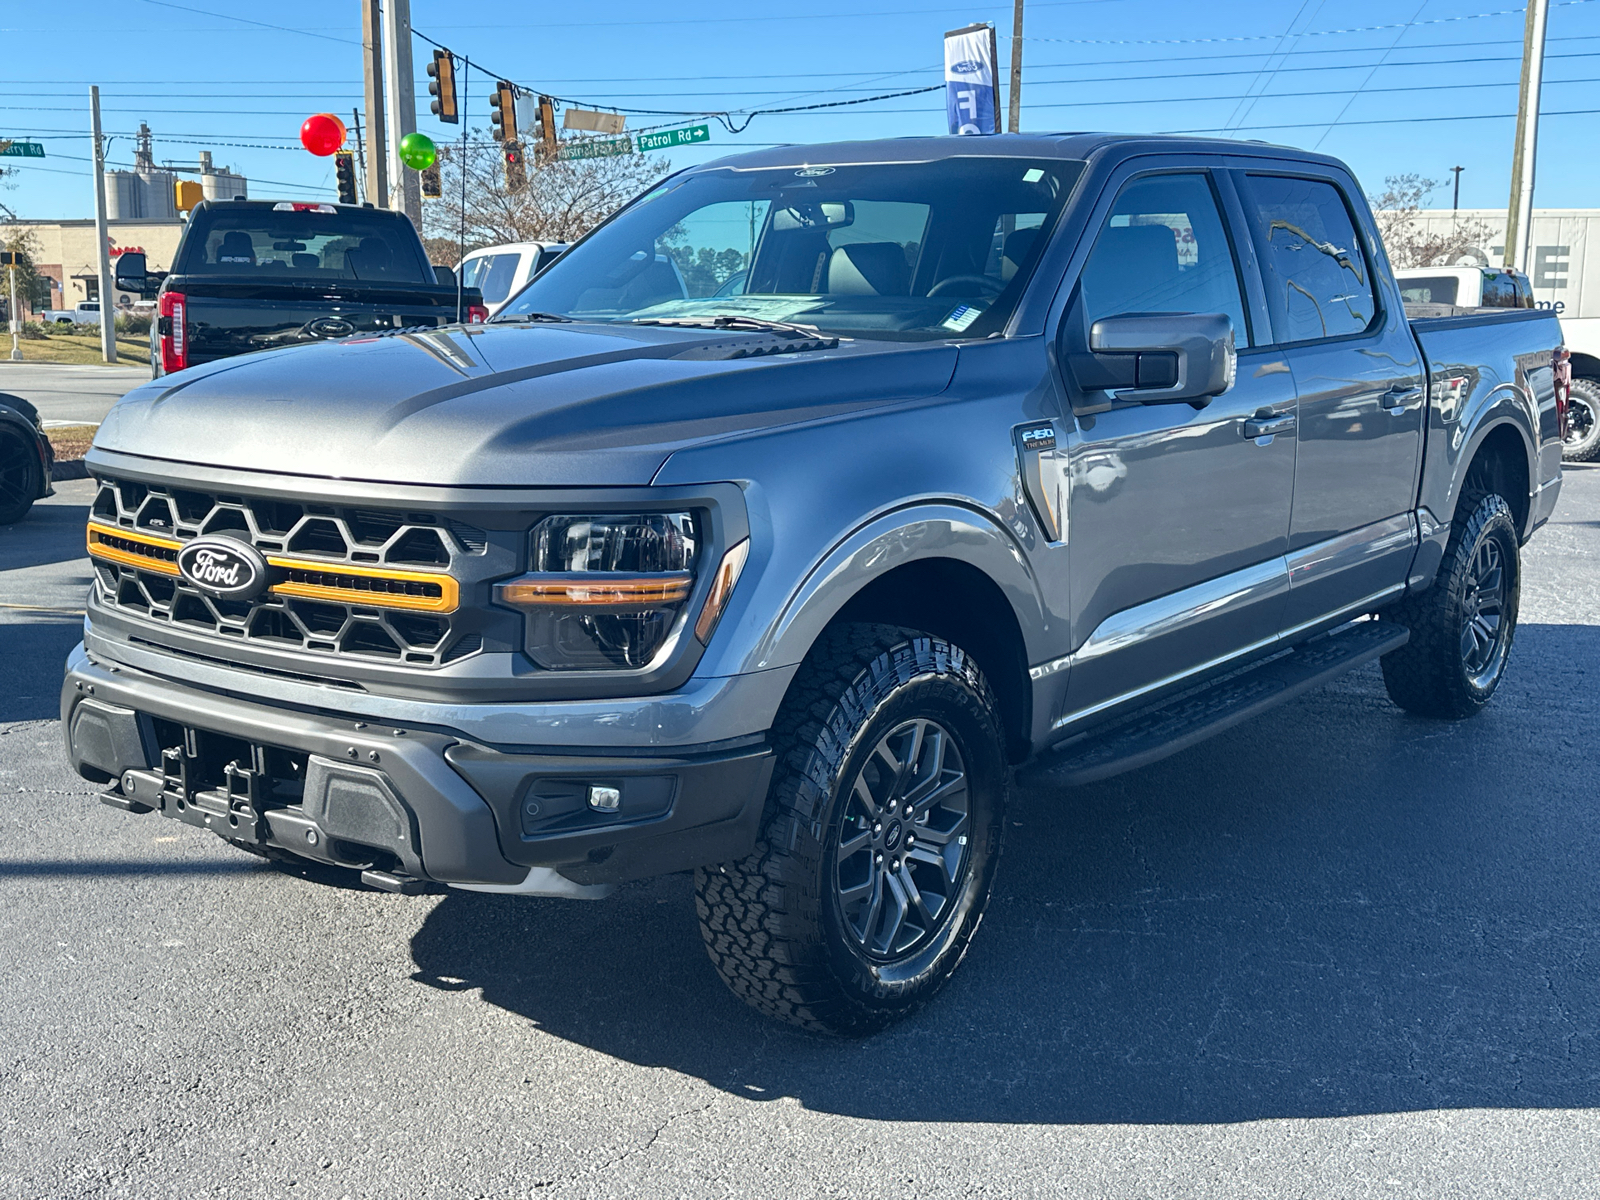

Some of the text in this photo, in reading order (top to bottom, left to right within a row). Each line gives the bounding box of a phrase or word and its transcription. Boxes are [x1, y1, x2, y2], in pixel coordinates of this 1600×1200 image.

[641, 129, 692, 148] Patrol Rd
[29, 144, 42, 154] Rd
[1022, 428, 1055, 442] F-150
[192, 549, 239, 586] Ford
